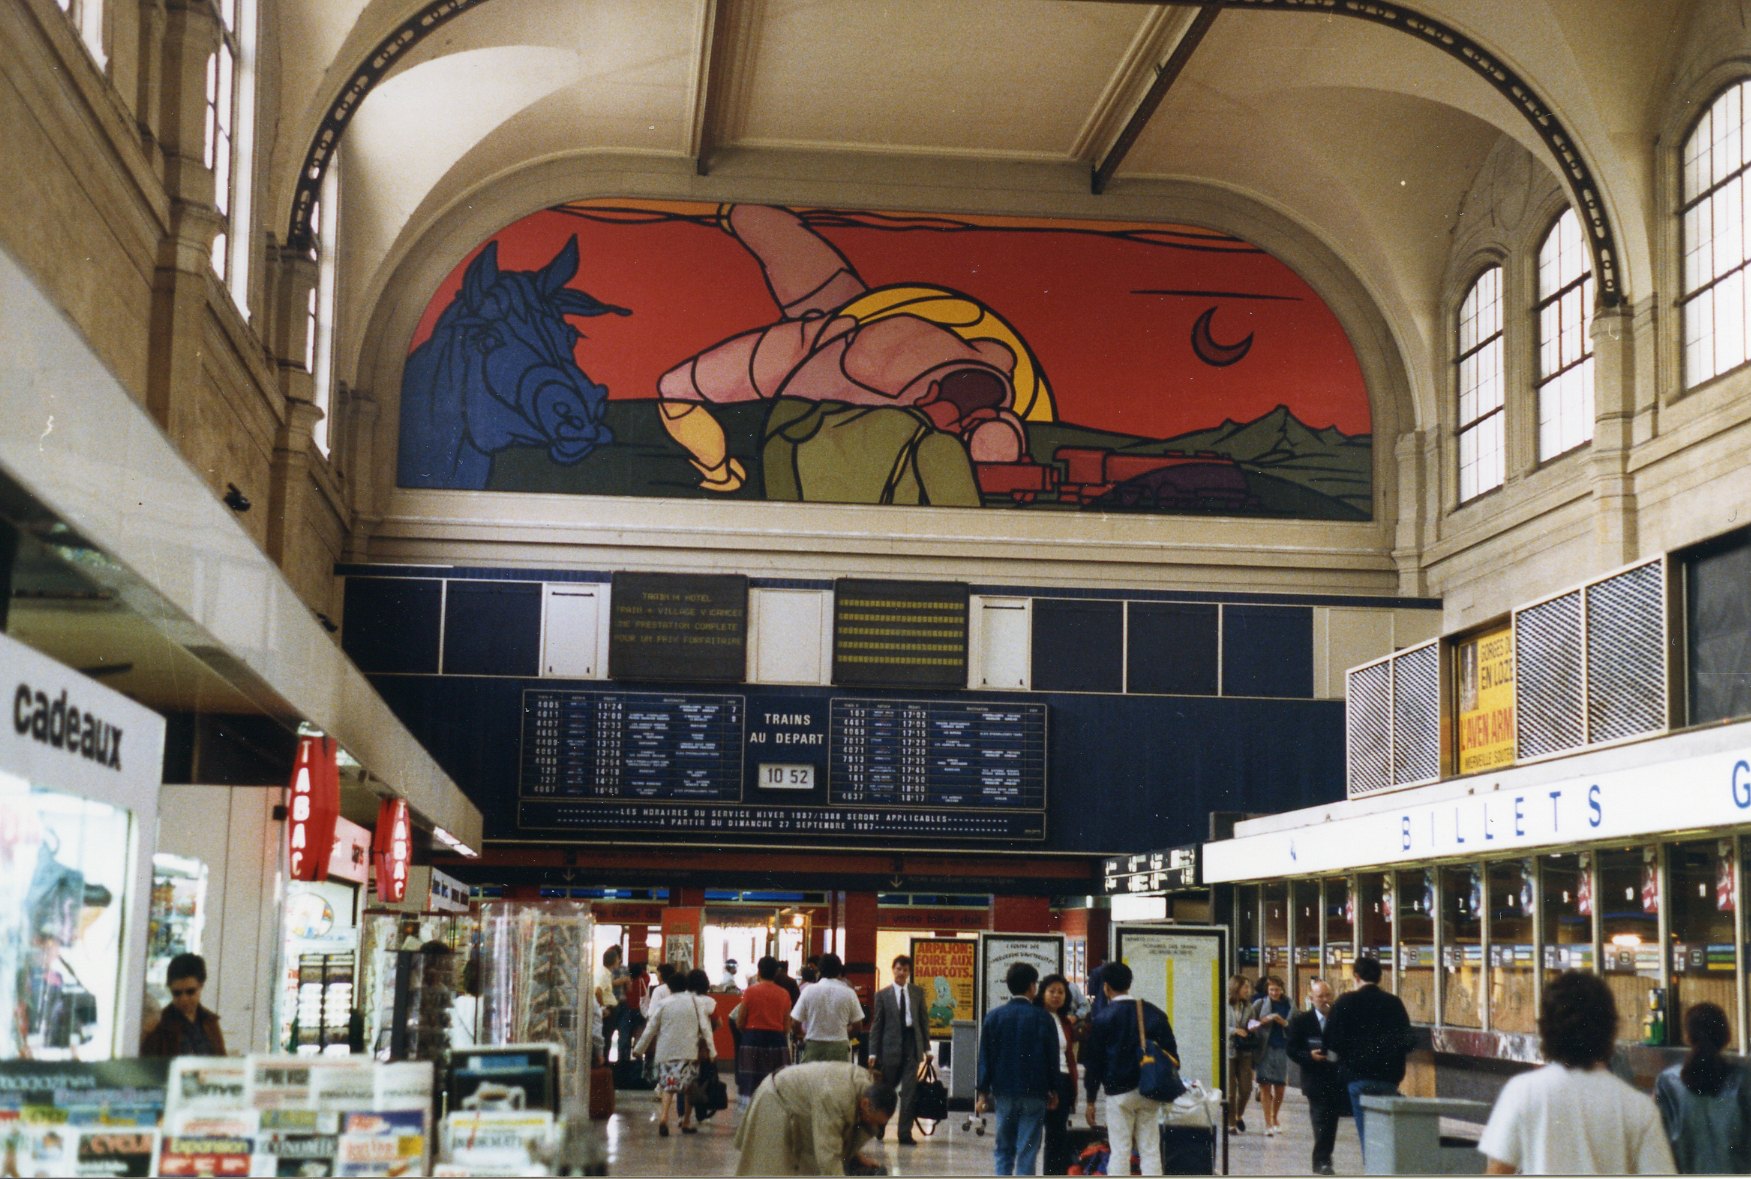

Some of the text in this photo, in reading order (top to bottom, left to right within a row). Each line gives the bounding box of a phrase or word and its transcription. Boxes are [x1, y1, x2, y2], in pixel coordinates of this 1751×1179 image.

[657, 607, 696, 616] VILLAGE
[694, 621, 738, 631] COMPLETE
[764, 713, 811, 726] TRAINS
[14, 683, 123, 772] cadeaux
[749, 732, 824, 745] AU DEPART
[768, 767, 808, 784] 10 52
[291, 740, 312, 876] TABAC
[620, 808, 637, 816] LES
[642, 808, 688, 817] HORAIRES
[712, 810, 750, 818] SERVICE
[847, 813, 880, 821] SERONT
[1402, 784, 1601, 852] BILLETS
[796, 821, 846, 830] SEPTEMBRE
[392, 800, 408, 899] TABAC
[917, 942, 972, 954] ARPAJON:
[915, 954, 972, 966] FOIRE AUX
[915, 966, 973, 978] HARICOTS.
